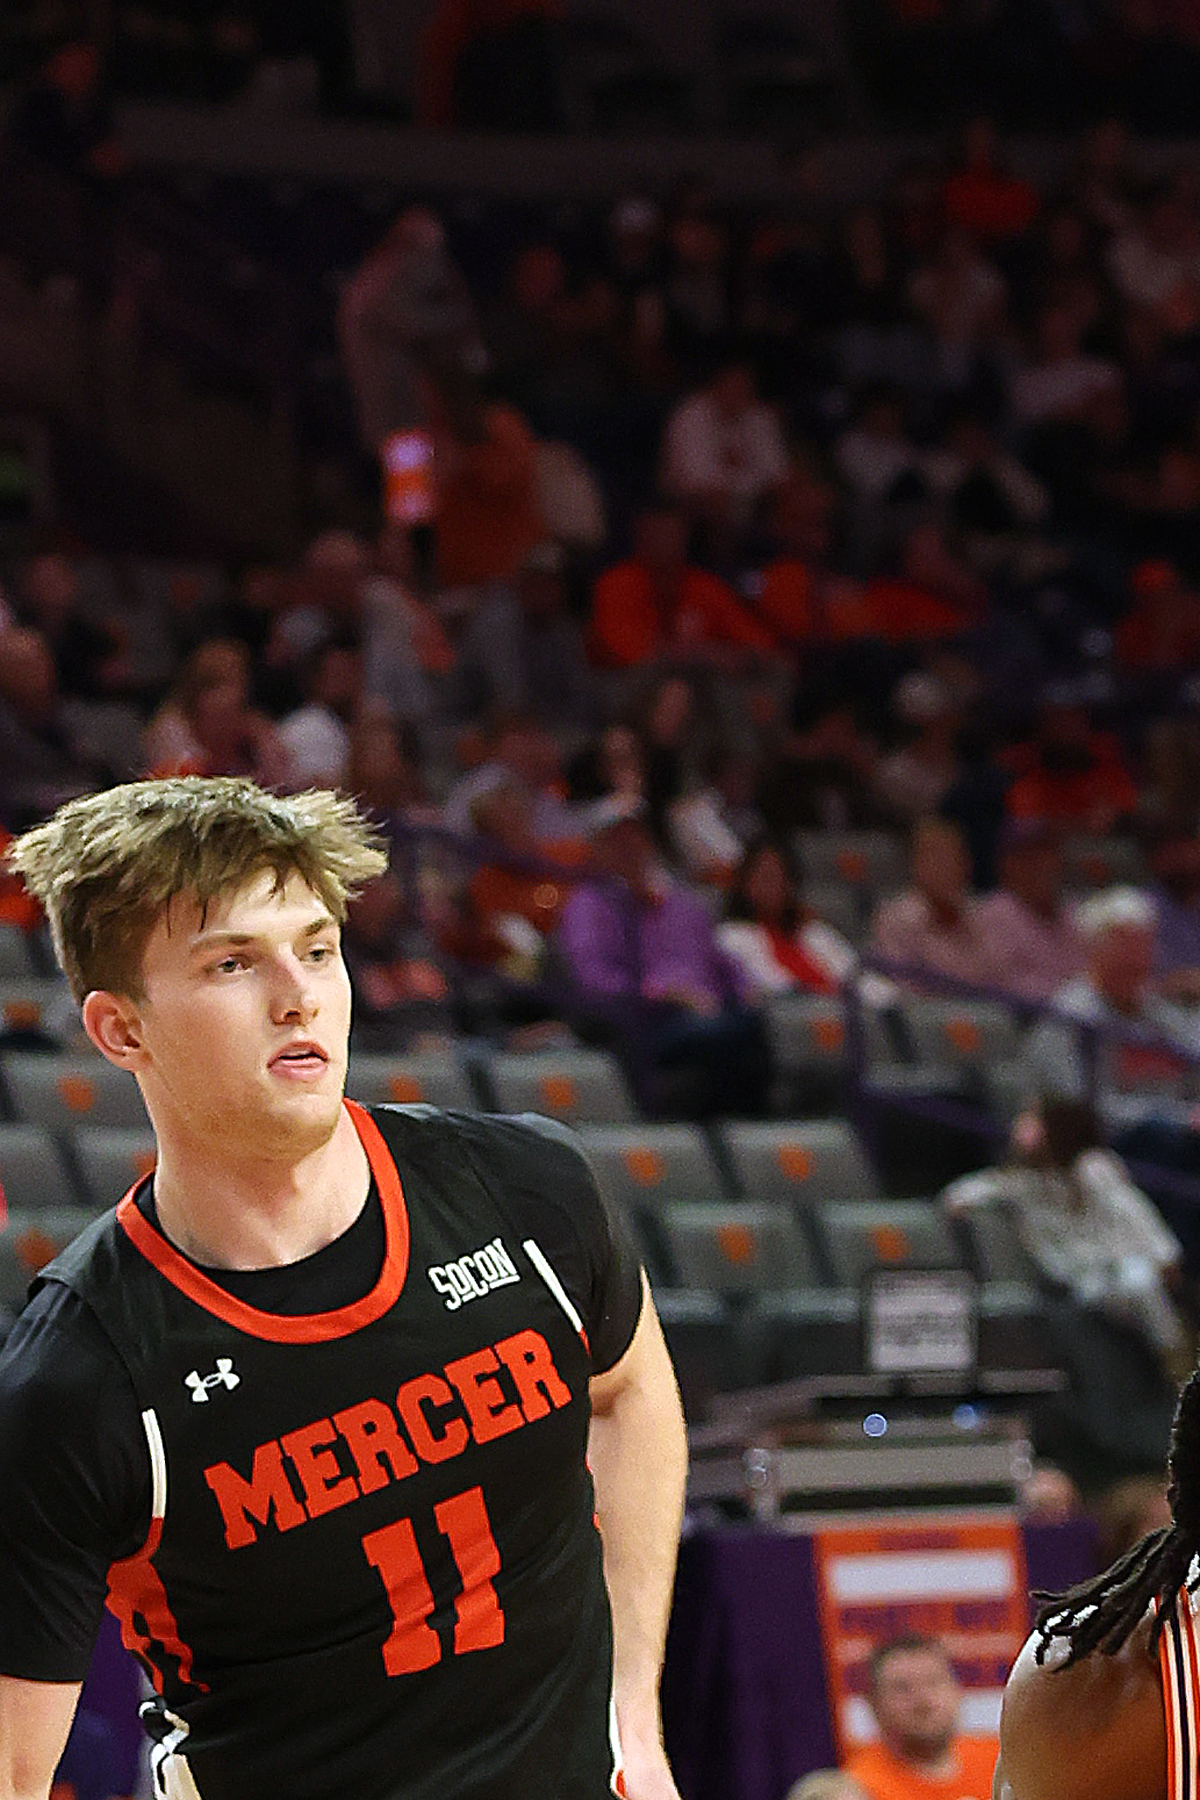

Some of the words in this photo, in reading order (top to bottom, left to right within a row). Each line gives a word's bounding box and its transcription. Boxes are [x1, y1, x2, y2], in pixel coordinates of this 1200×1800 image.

[427, 1236, 521, 1311] SOCON
[203, 1328, 573, 1551] MERCER
[361, 1486, 506, 1679] 11
